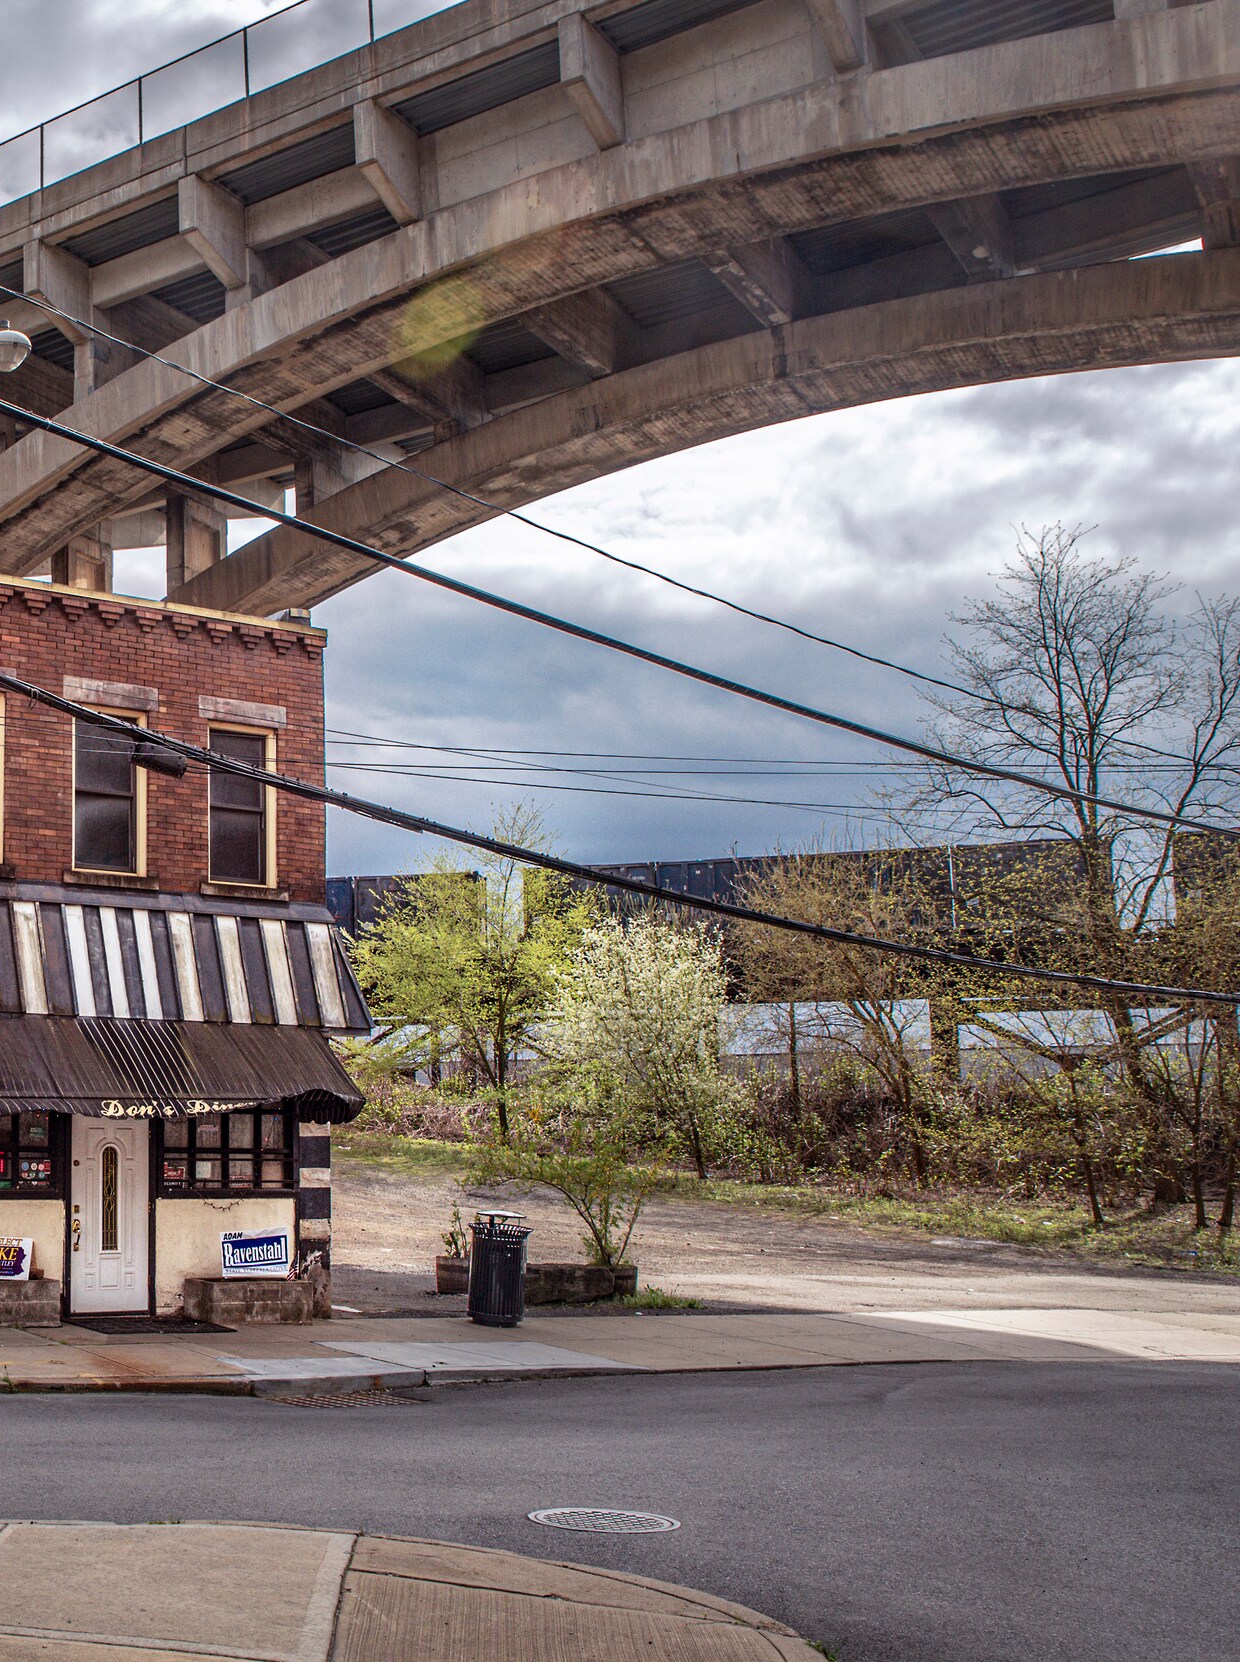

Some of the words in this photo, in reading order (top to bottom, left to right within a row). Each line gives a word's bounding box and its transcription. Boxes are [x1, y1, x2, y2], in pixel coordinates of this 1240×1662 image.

[100, 1099, 175, 1118] Don's
[223, 1231, 243, 1241] ADAM
[223, 1237, 287, 1267] Ravenstahl
